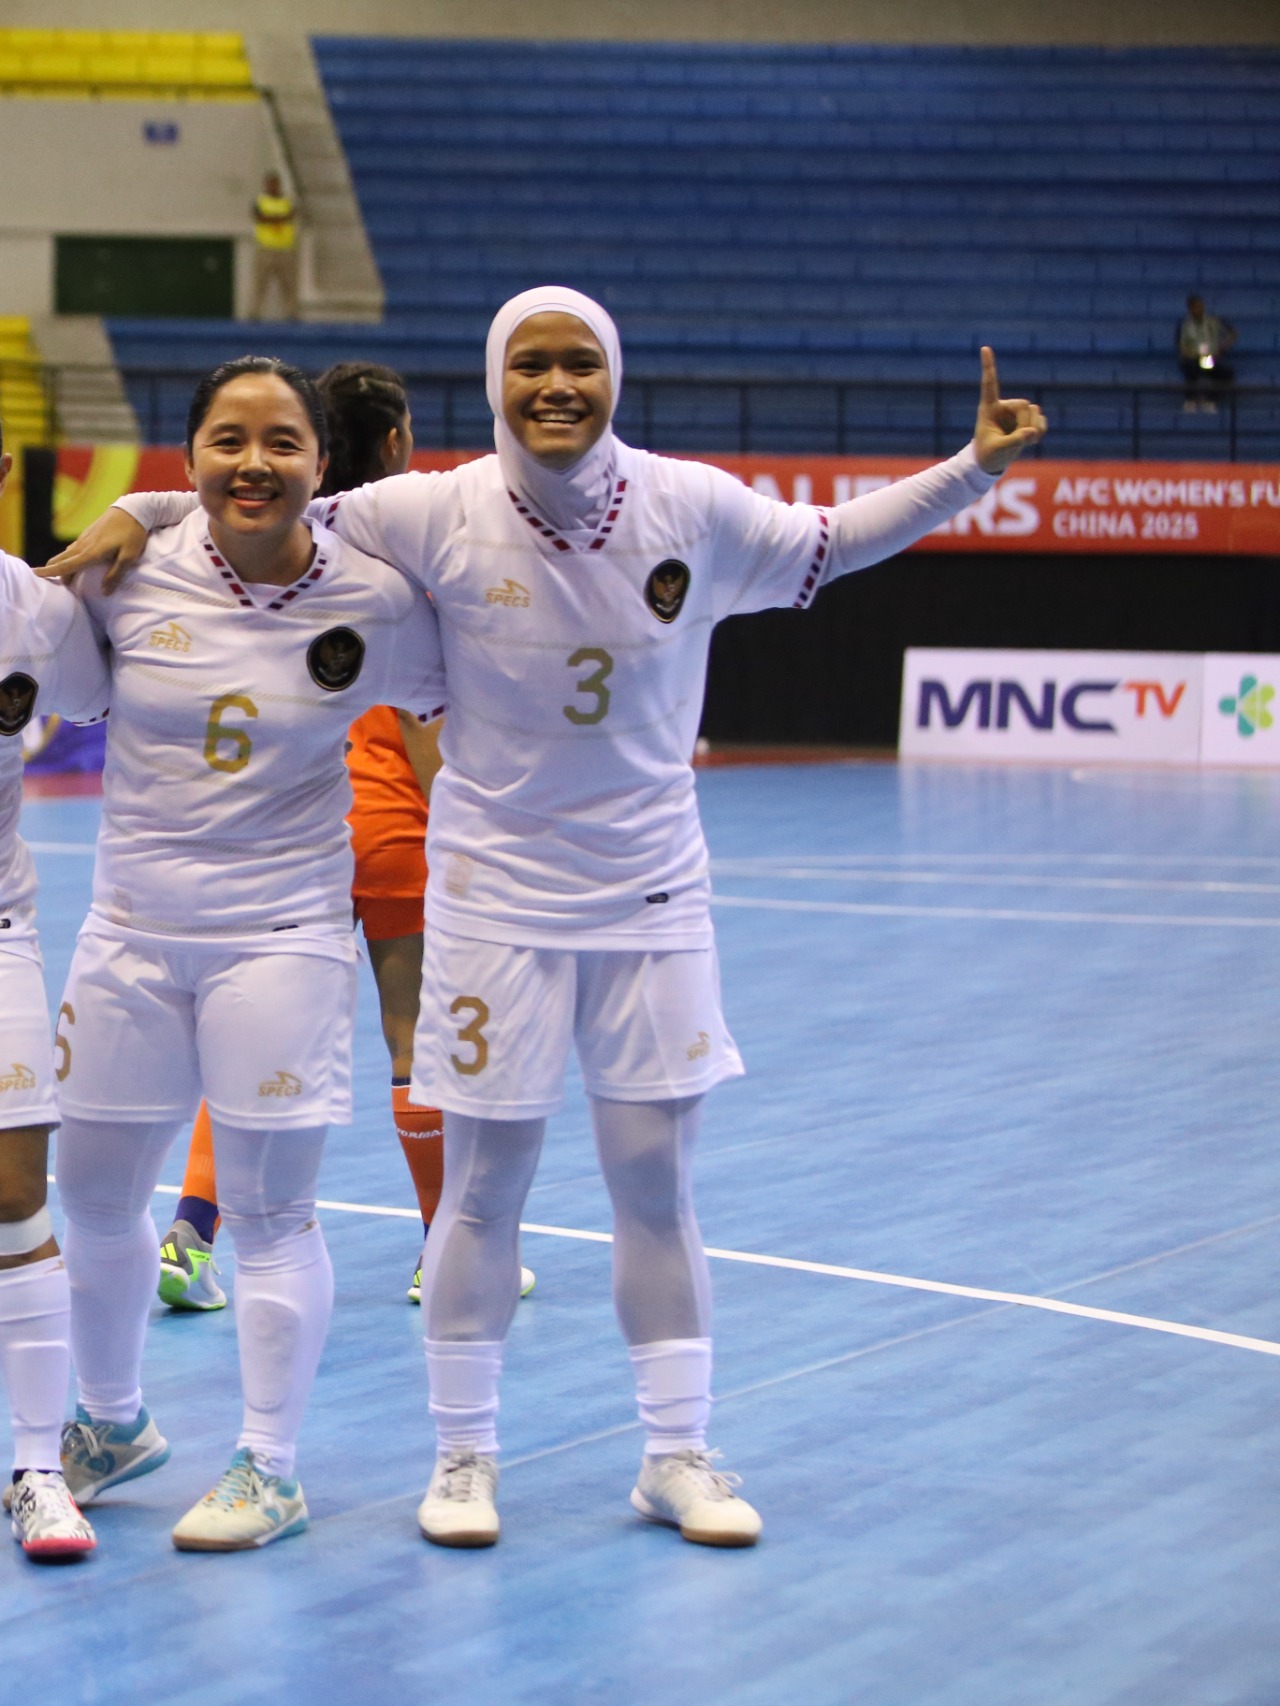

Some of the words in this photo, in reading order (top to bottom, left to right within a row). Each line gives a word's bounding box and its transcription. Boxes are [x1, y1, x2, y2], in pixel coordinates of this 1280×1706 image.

[1053, 478, 1110, 506] AFC
[1113, 478, 1247, 508] WOMEN'S
[1052, 510, 1137, 538] CHINA
[1141, 511, 1199, 540] 2025
[485, 592, 530, 608] SPECS
[563, 647, 613, 724] 3
[917, 679, 1120, 733] MNC
[1124, 680, 1186, 718] TV
[203, 694, 258, 773] 6
[450, 997, 489, 1075] 3
[257, 1084, 302, 1098] SPECS
